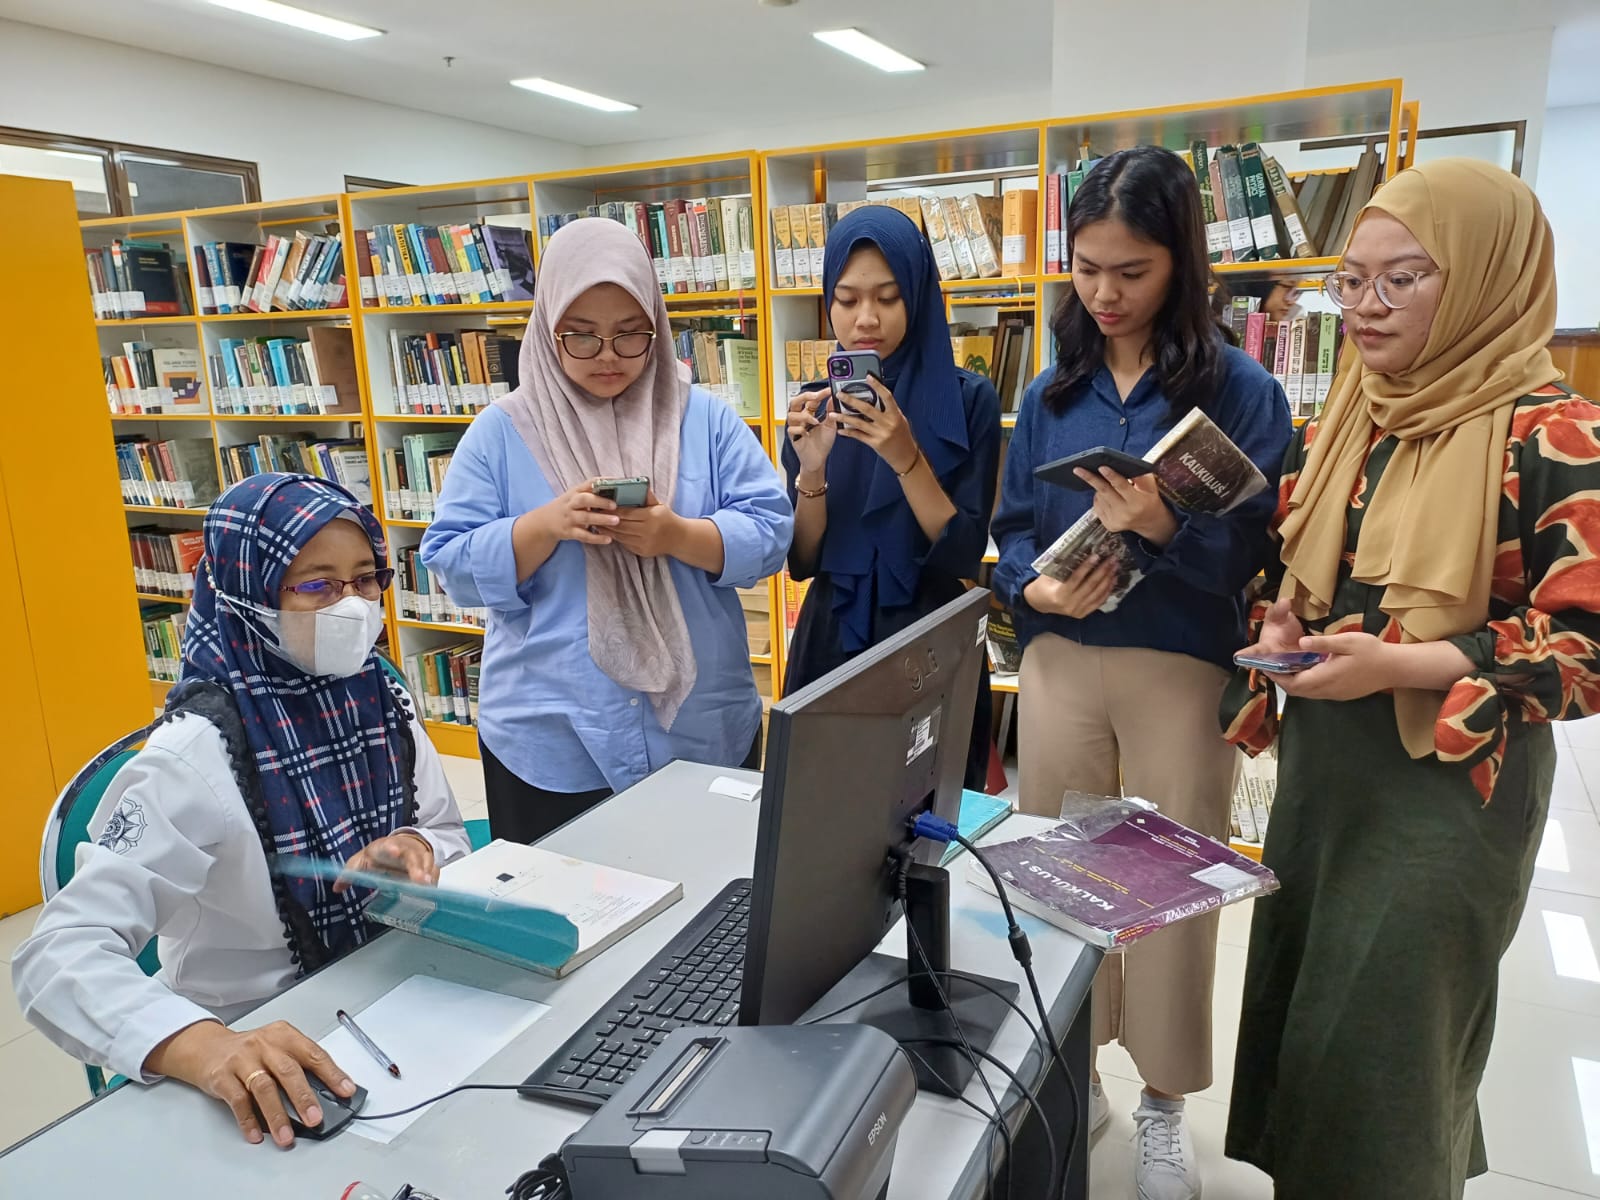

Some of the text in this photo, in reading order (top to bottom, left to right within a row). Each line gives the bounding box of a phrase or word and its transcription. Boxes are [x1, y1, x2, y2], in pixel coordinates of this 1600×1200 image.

[1179, 452, 1226, 496] KALKULUS
[1028, 865, 1115, 911] KALKULUS
[867, 1111, 887, 1147] EPSON
